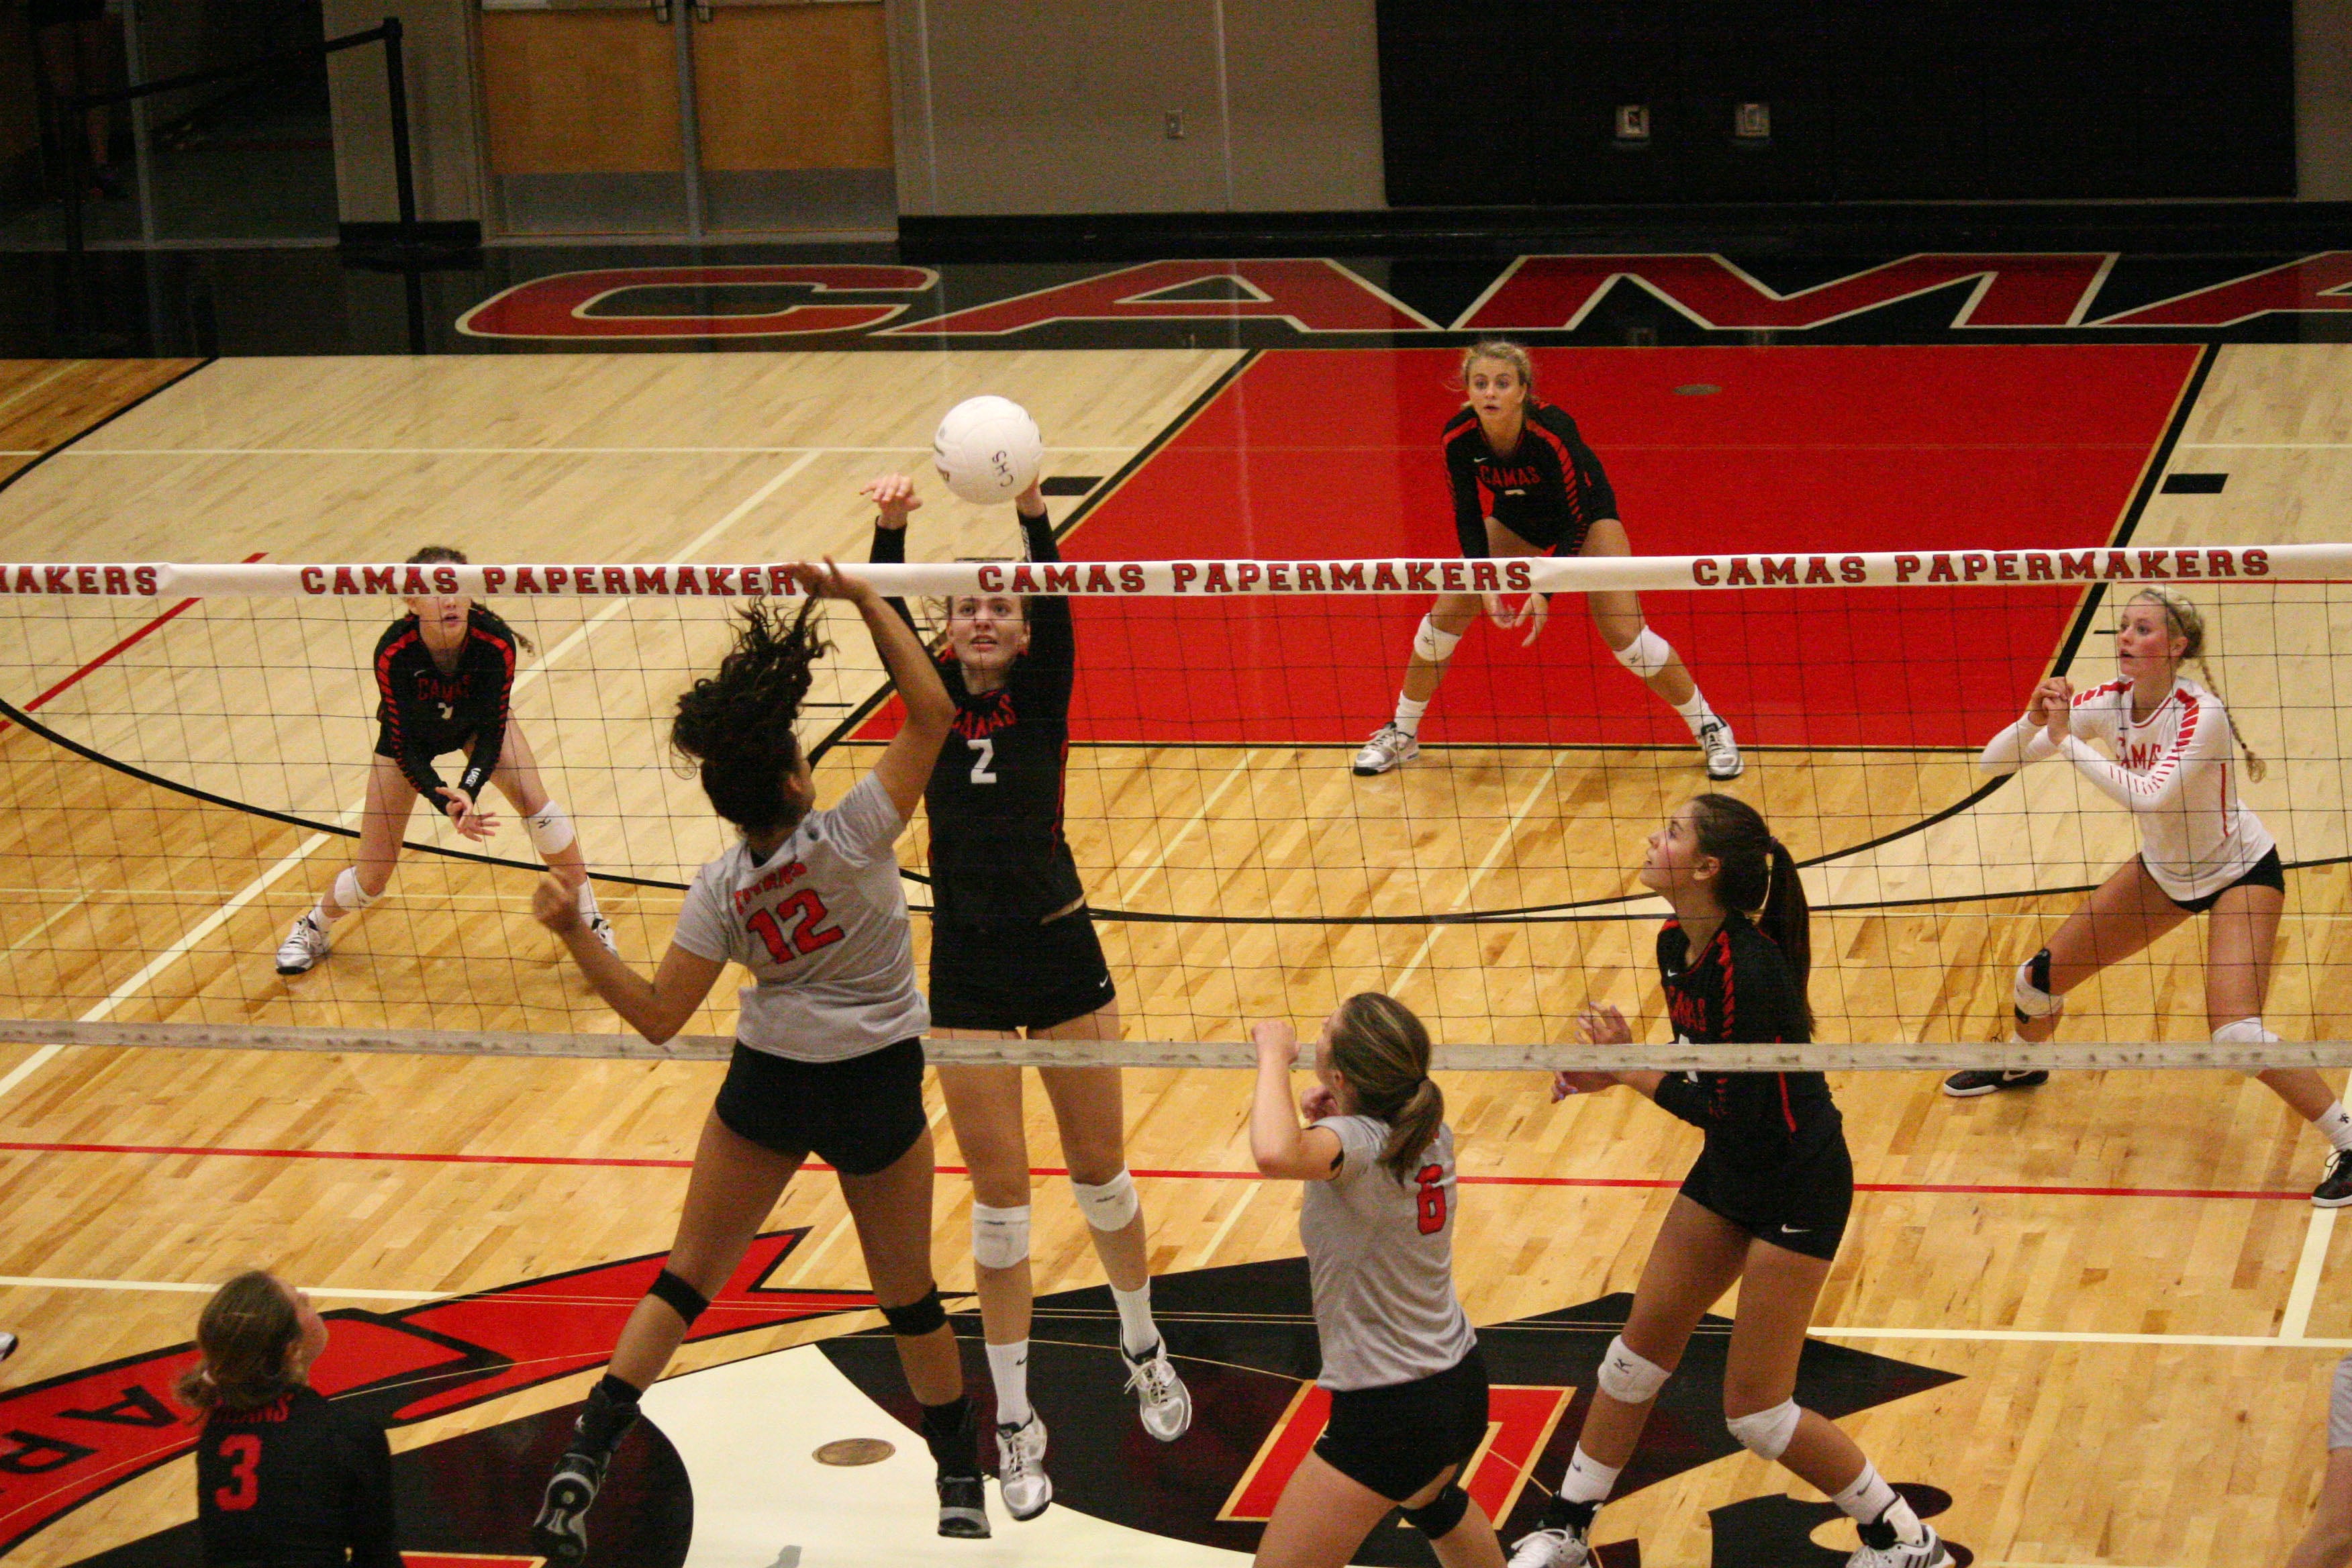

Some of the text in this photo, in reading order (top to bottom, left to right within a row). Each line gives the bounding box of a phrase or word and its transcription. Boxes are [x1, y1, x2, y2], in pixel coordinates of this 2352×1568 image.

[1478, 464, 1542, 487] CAMAS
[301, 567, 797, 596] CAMAS PAPERMAKER
[978, 561, 1532, 593] CAMAS PAPERMAKERS
[1692, 548, 2269, 586] CAMAS PAPERMAKERS
[967, 738, 997, 784] 2
[746, 888, 846, 965] 12
[1414, 1163, 1447, 1236] 6
[215, 1433, 262, 1511] 3
